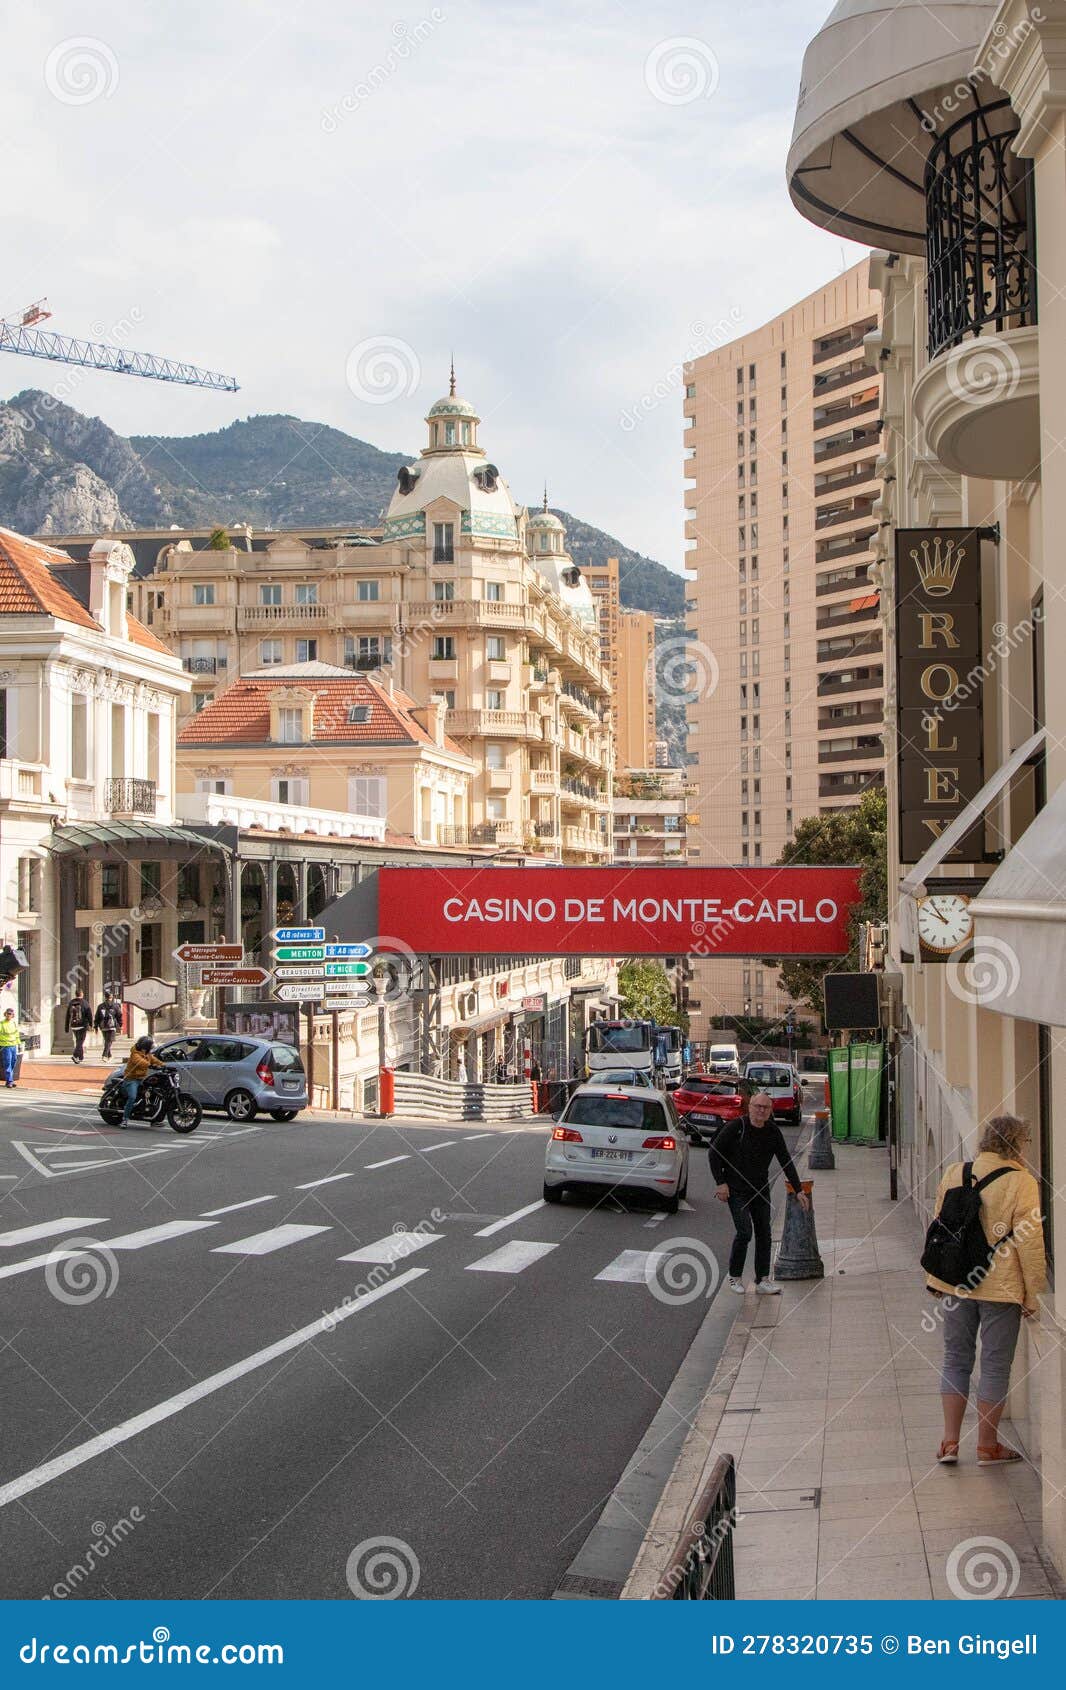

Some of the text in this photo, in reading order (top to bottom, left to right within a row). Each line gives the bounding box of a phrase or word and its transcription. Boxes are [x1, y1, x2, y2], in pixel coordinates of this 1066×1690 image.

[443, 898, 838, 923] CASINO DE MONTE-CARLO
[290, 950, 322, 958] MENTON
[281, 968, 321, 976] BEAUSOLEIL
[337, 965, 352, 973] NICE
